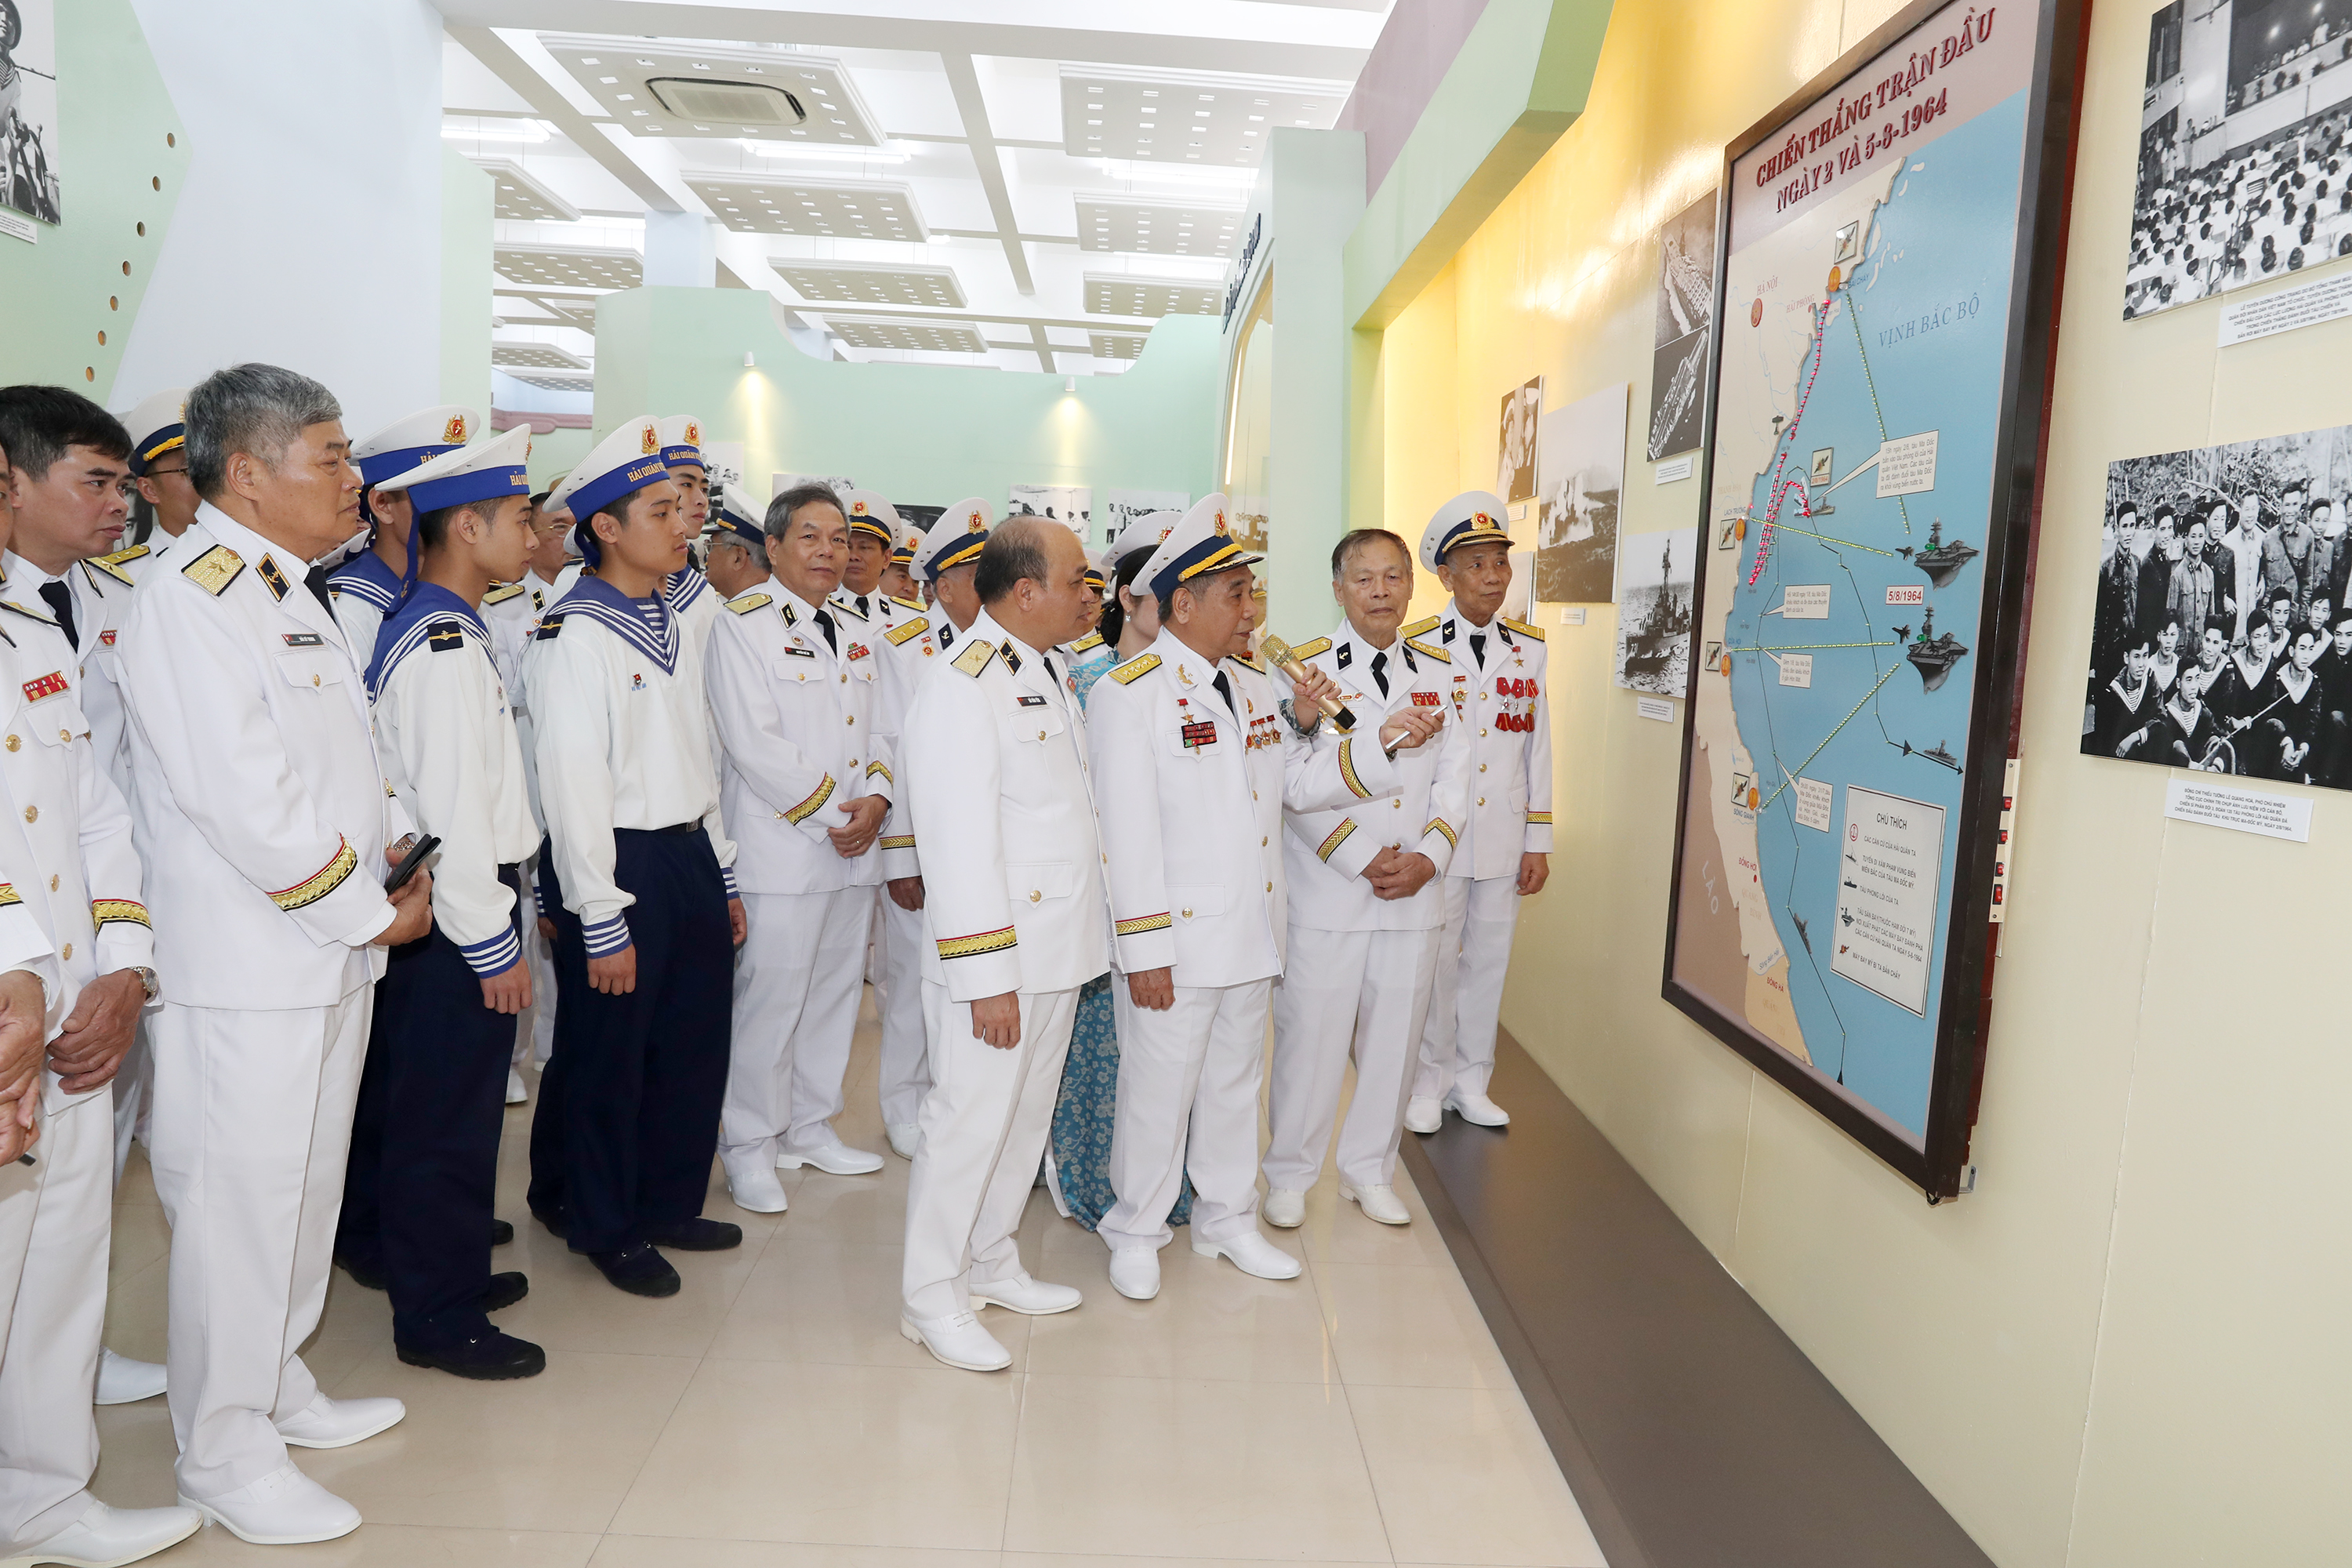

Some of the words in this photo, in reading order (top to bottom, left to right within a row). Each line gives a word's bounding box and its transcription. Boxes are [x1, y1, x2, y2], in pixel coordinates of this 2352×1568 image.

[1756, 133, 1806, 187] CHIẾN
[1808, 98, 1872, 154] THẮNG
[1876, 47, 1937, 108] TRẬN
[1939, 7, 1996, 68] ĐẦU
[1776, 161, 1827, 213] NGÀY
[1824, 163, 1834, 184] 2
[1836, 135, 1861, 175] VÀ
[1864, 87, 1947, 160] 5-8-1964
[1757, 280, 1765, 296] HÀ
[1766, 275, 1778, 292] NỘI
[1787, 300, 1796, 313] HẢI
[1796, 294, 1815, 309] PHÒNG
[1878, 320, 1916, 348] VỊNH
[1920, 303, 1951, 334] BẮC
[1956, 292, 1980, 320] BỘ
[668, 450, 681, 460] HẢI
[627, 466, 644, 482] HẢI
[642, 462, 660, 477] QUÂN
[1888, 591, 1922, 601] 5/8/1964
[1733, 808, 1743, 817] SÔNG
[1876, 811, 1888, 825] CHÚ
[1889, 815, 1907, 830] THÍCH
[1739, 856, 1749, 868] ĐỒNG
[1702, 860, 1719, 915] LÀO
